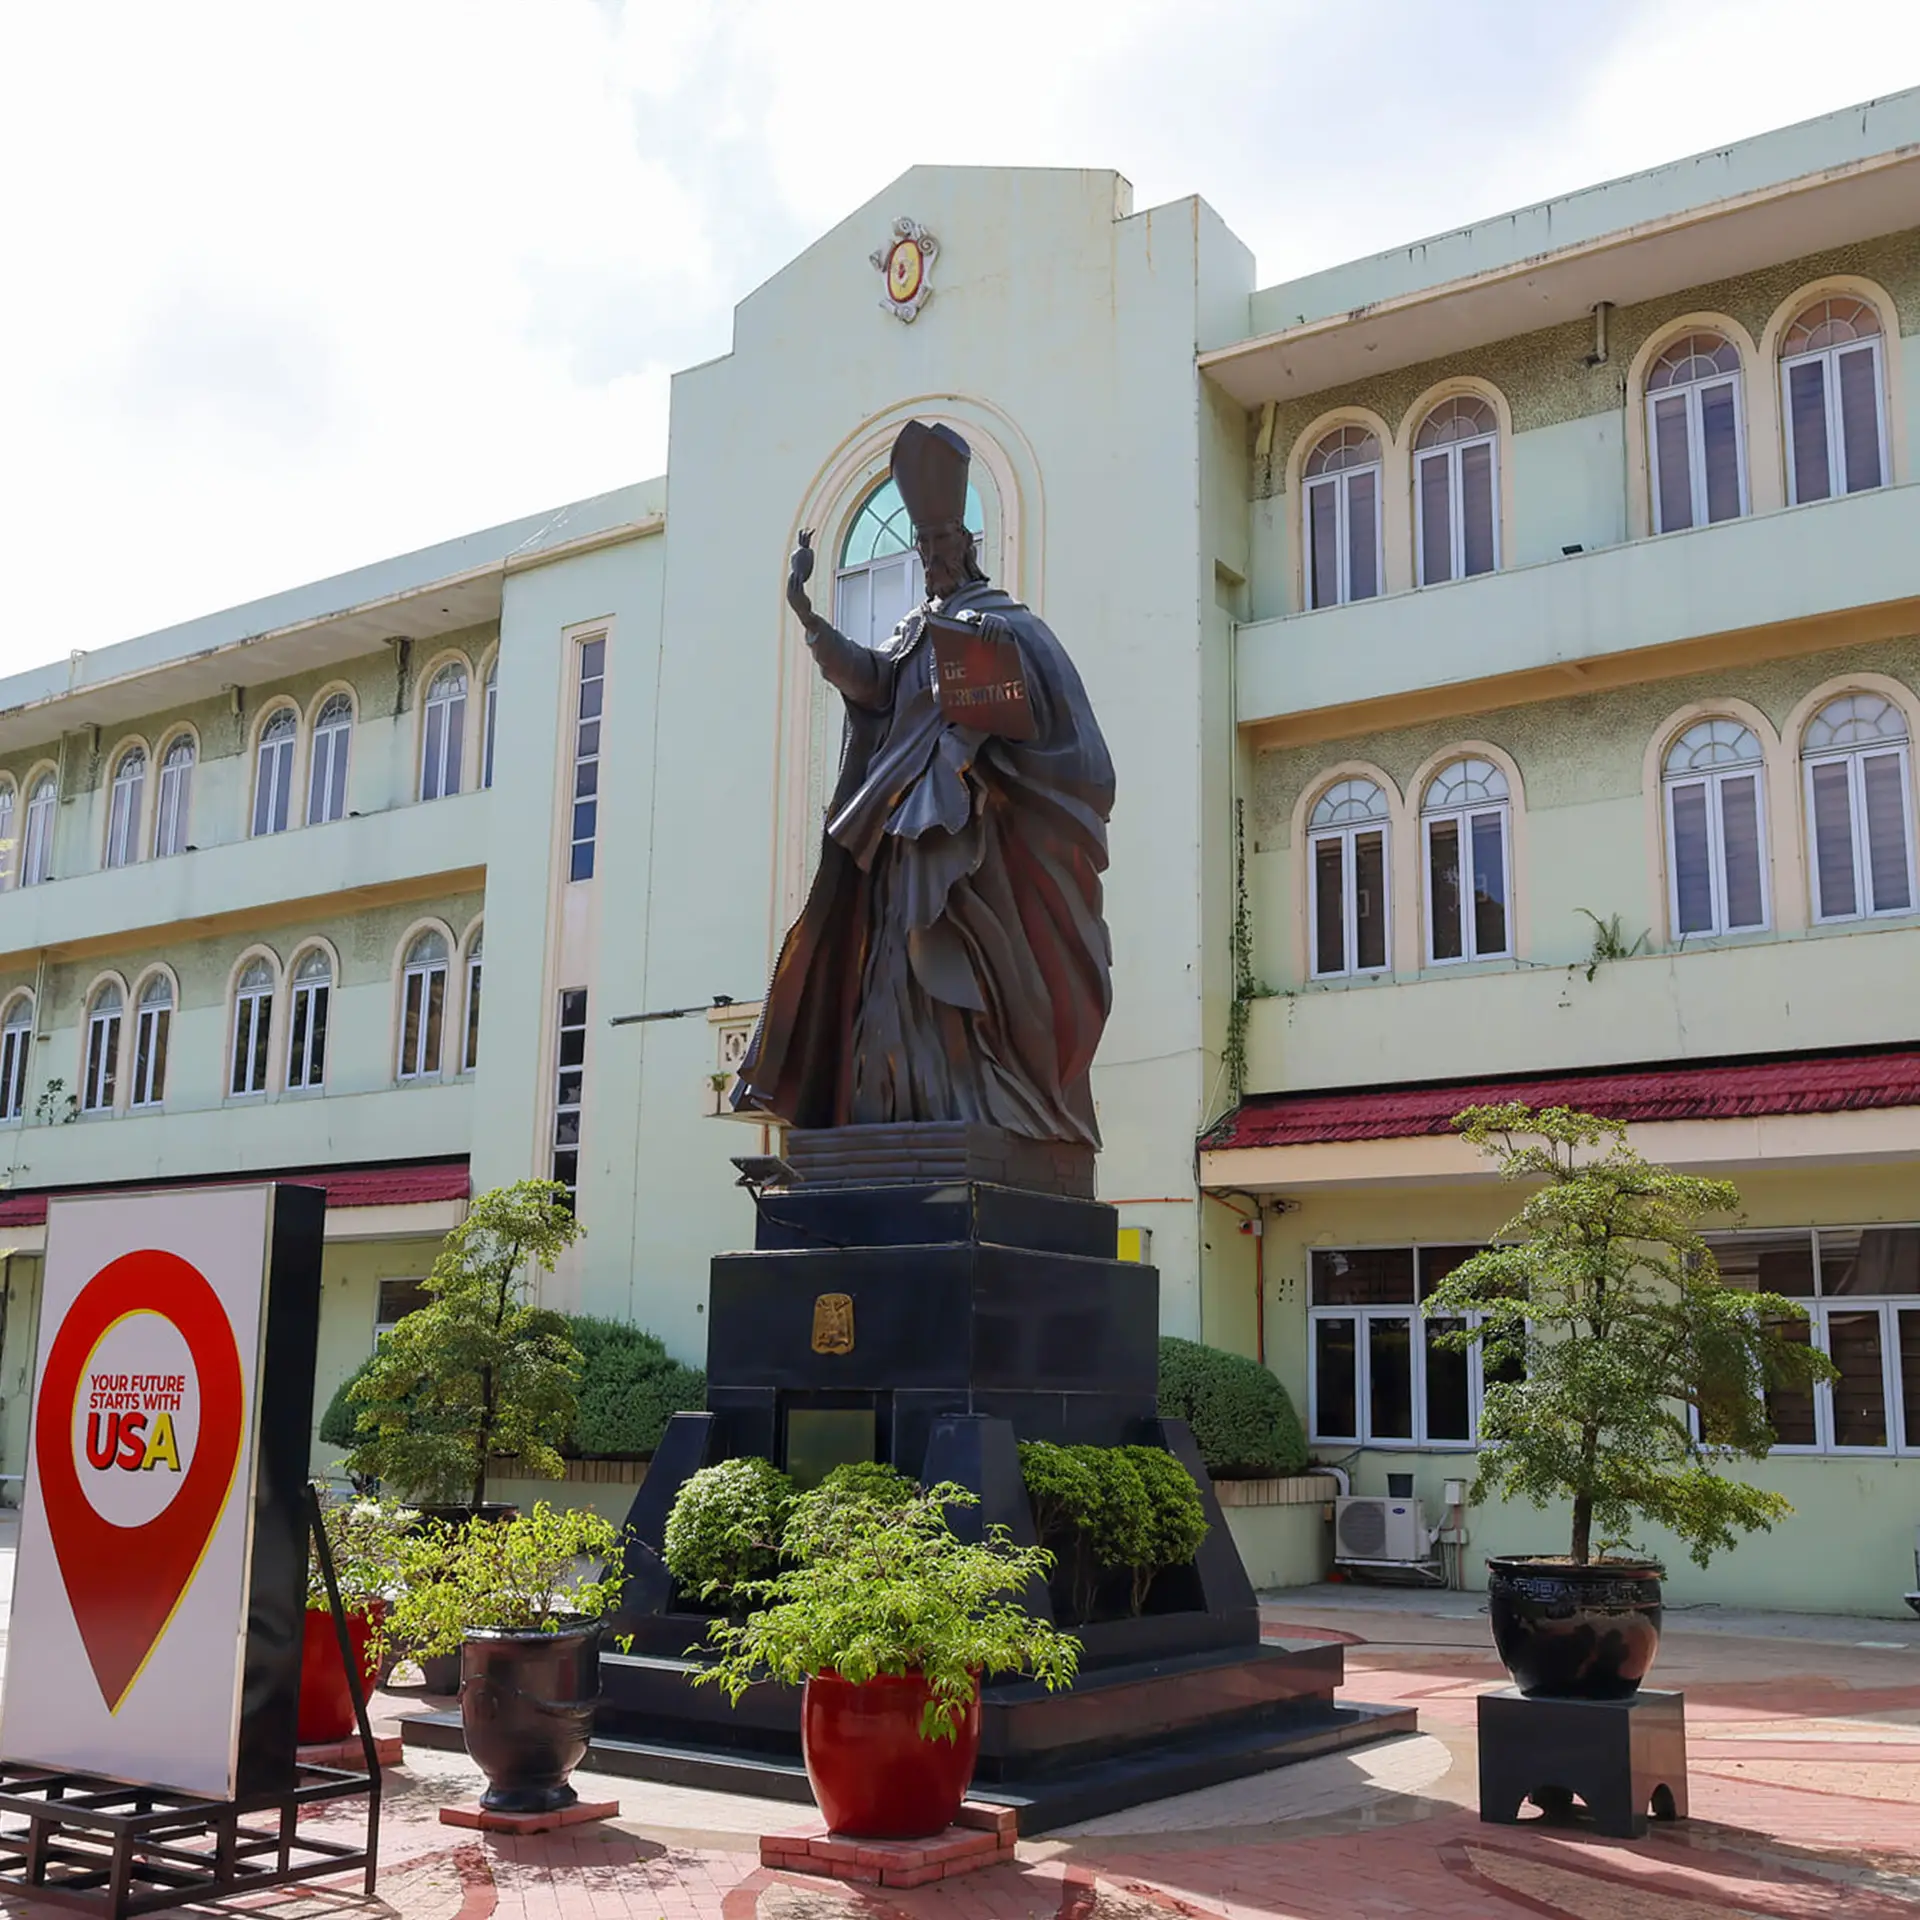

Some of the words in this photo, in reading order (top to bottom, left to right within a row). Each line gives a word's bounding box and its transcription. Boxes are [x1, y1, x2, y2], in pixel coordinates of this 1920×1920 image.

[943, 661, 967, 680] DE
[91, 1375, 128, 1391] YOUR
[131, 1375, 185, 1392] FUTURE
[90, 1392, 140, 1410] STARTS
[143, 1394, 181, 1411] WITH
[86, 1412, 181, 1472] USA
